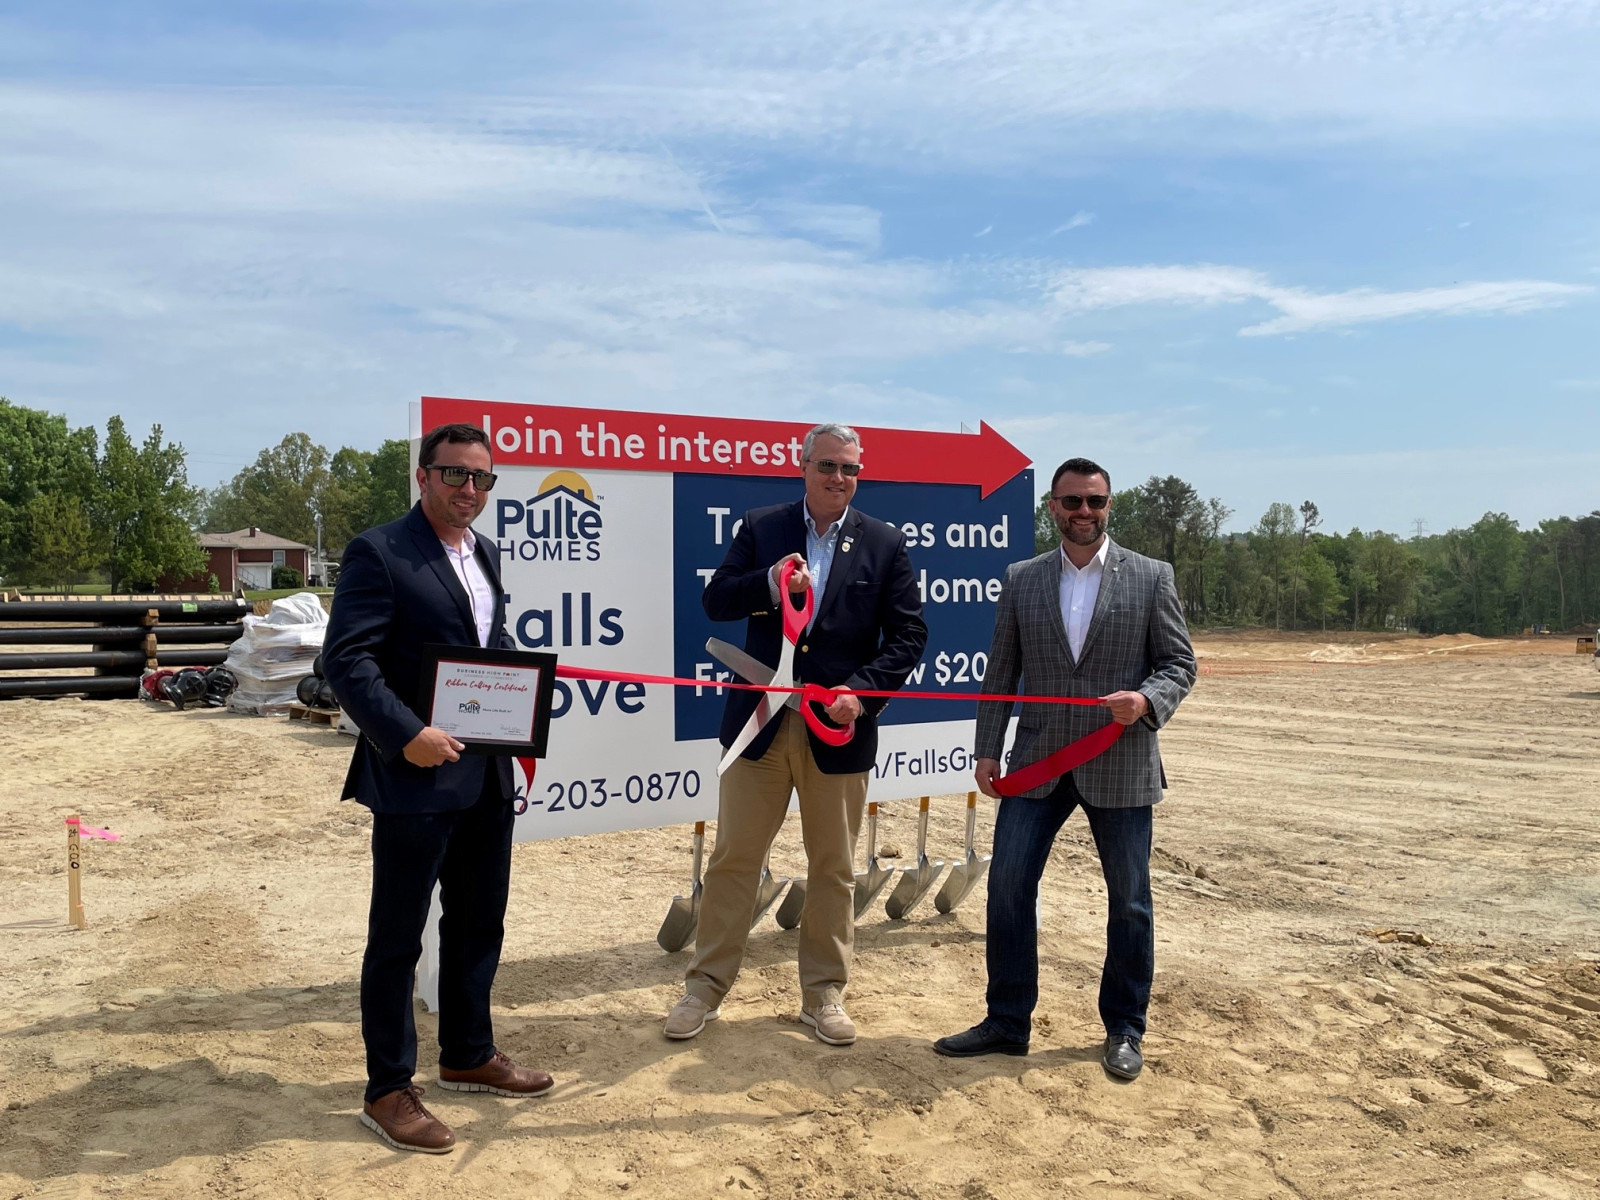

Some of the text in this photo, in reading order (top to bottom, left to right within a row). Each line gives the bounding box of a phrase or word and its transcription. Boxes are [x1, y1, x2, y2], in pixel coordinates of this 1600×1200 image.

[576, 421, 645, 459] the
[658, 424, 803, 467] interest
[497, 496, 602, 540] Pulte
[945, 515, 1009, 548] and
[497, 540, 601, 561] HOMES
[505, 592, 624, 648] alls
[695, 663, 735, 696] Fr
[459, 702, 480, 711] Pulte
[550, 679, 646, 719] ove
